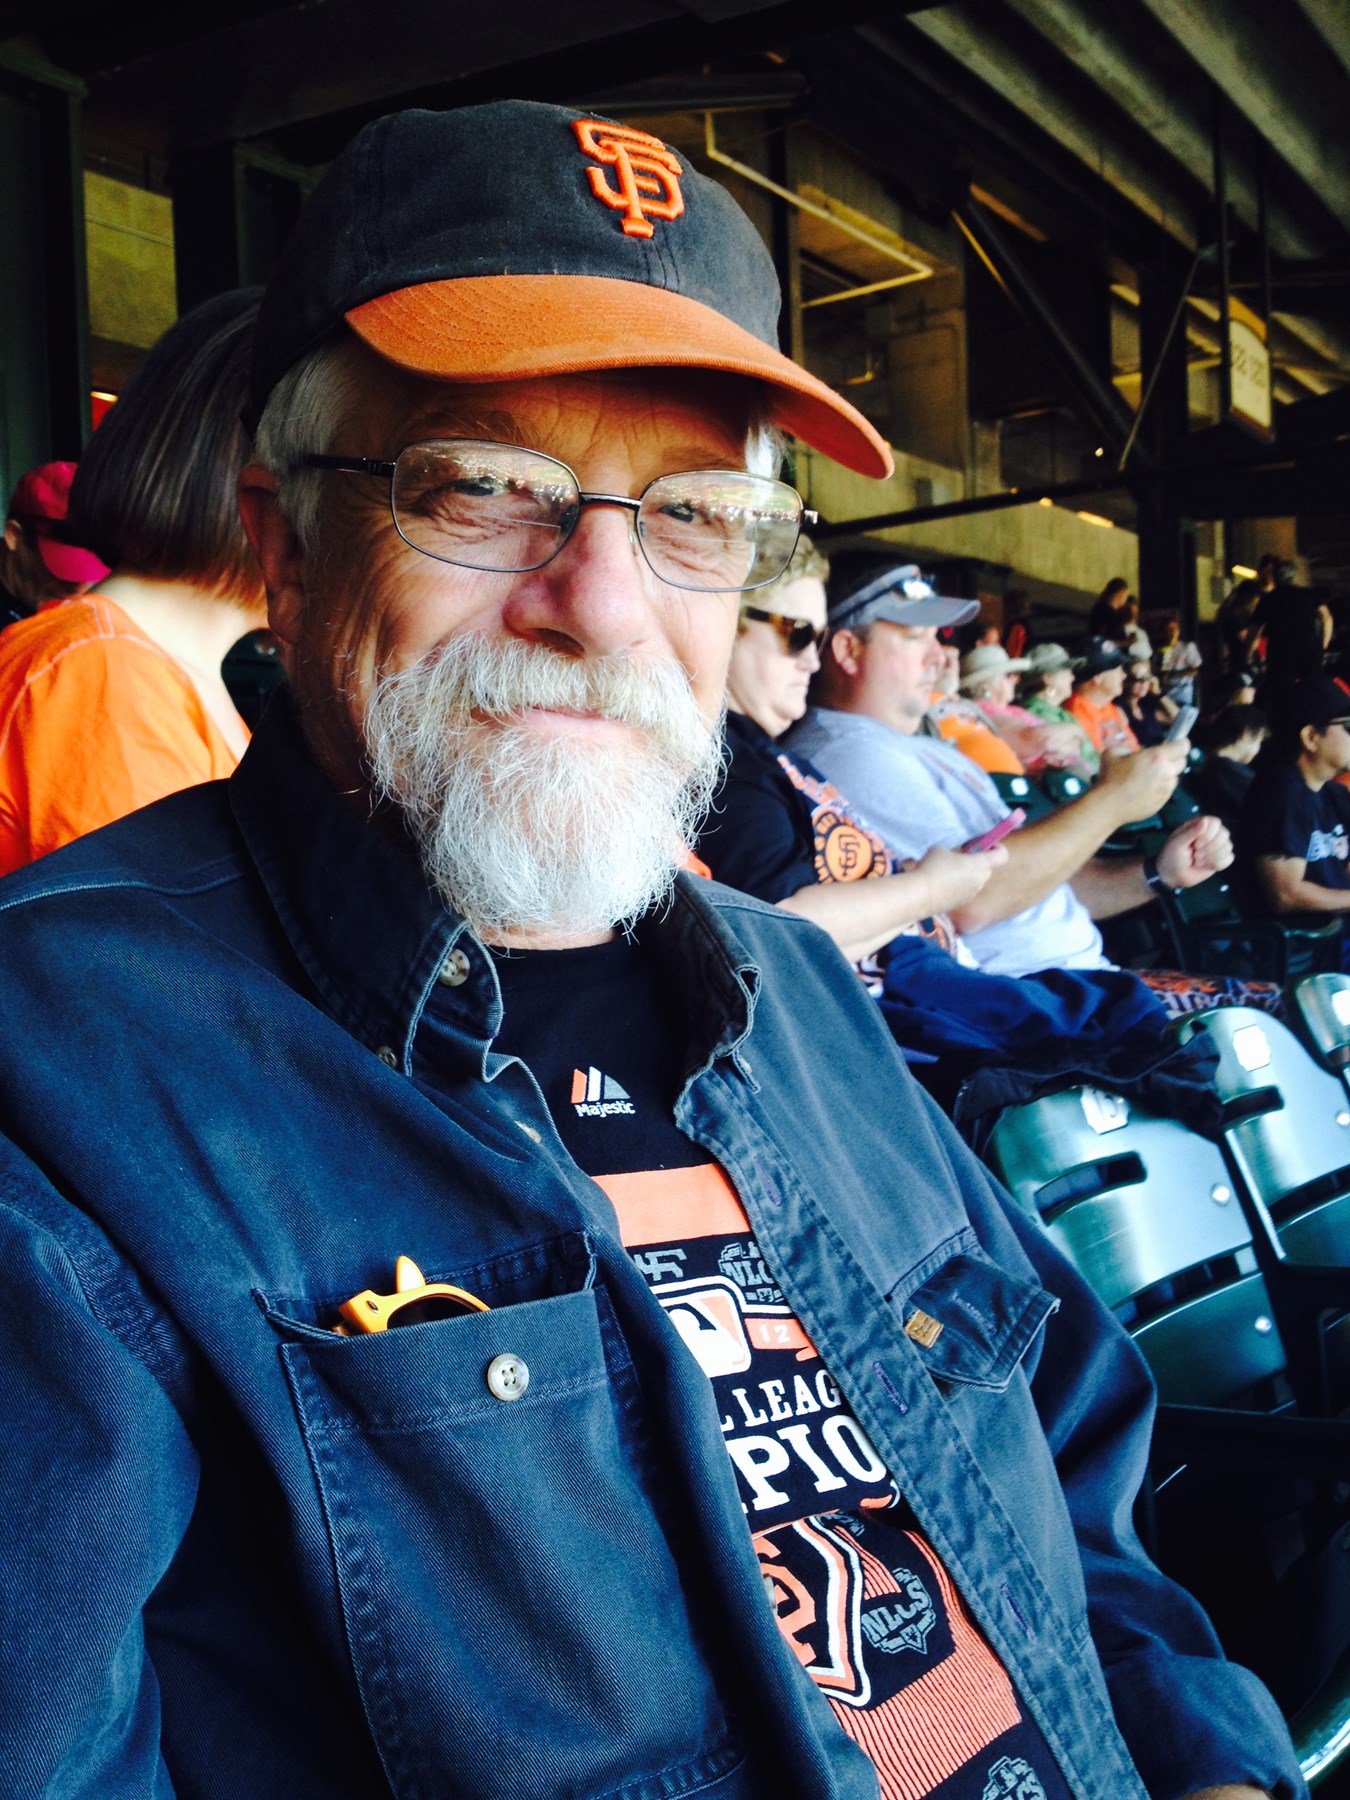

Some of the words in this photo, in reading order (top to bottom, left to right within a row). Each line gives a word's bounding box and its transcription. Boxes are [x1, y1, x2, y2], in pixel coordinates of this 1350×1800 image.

[574, 1100, 636, 1118] Majestic
[759, 1323, 791, 1344] 12
[725, 1414, 887, 1513] PIO
[861, 1577, 931, 1643] NLCS
